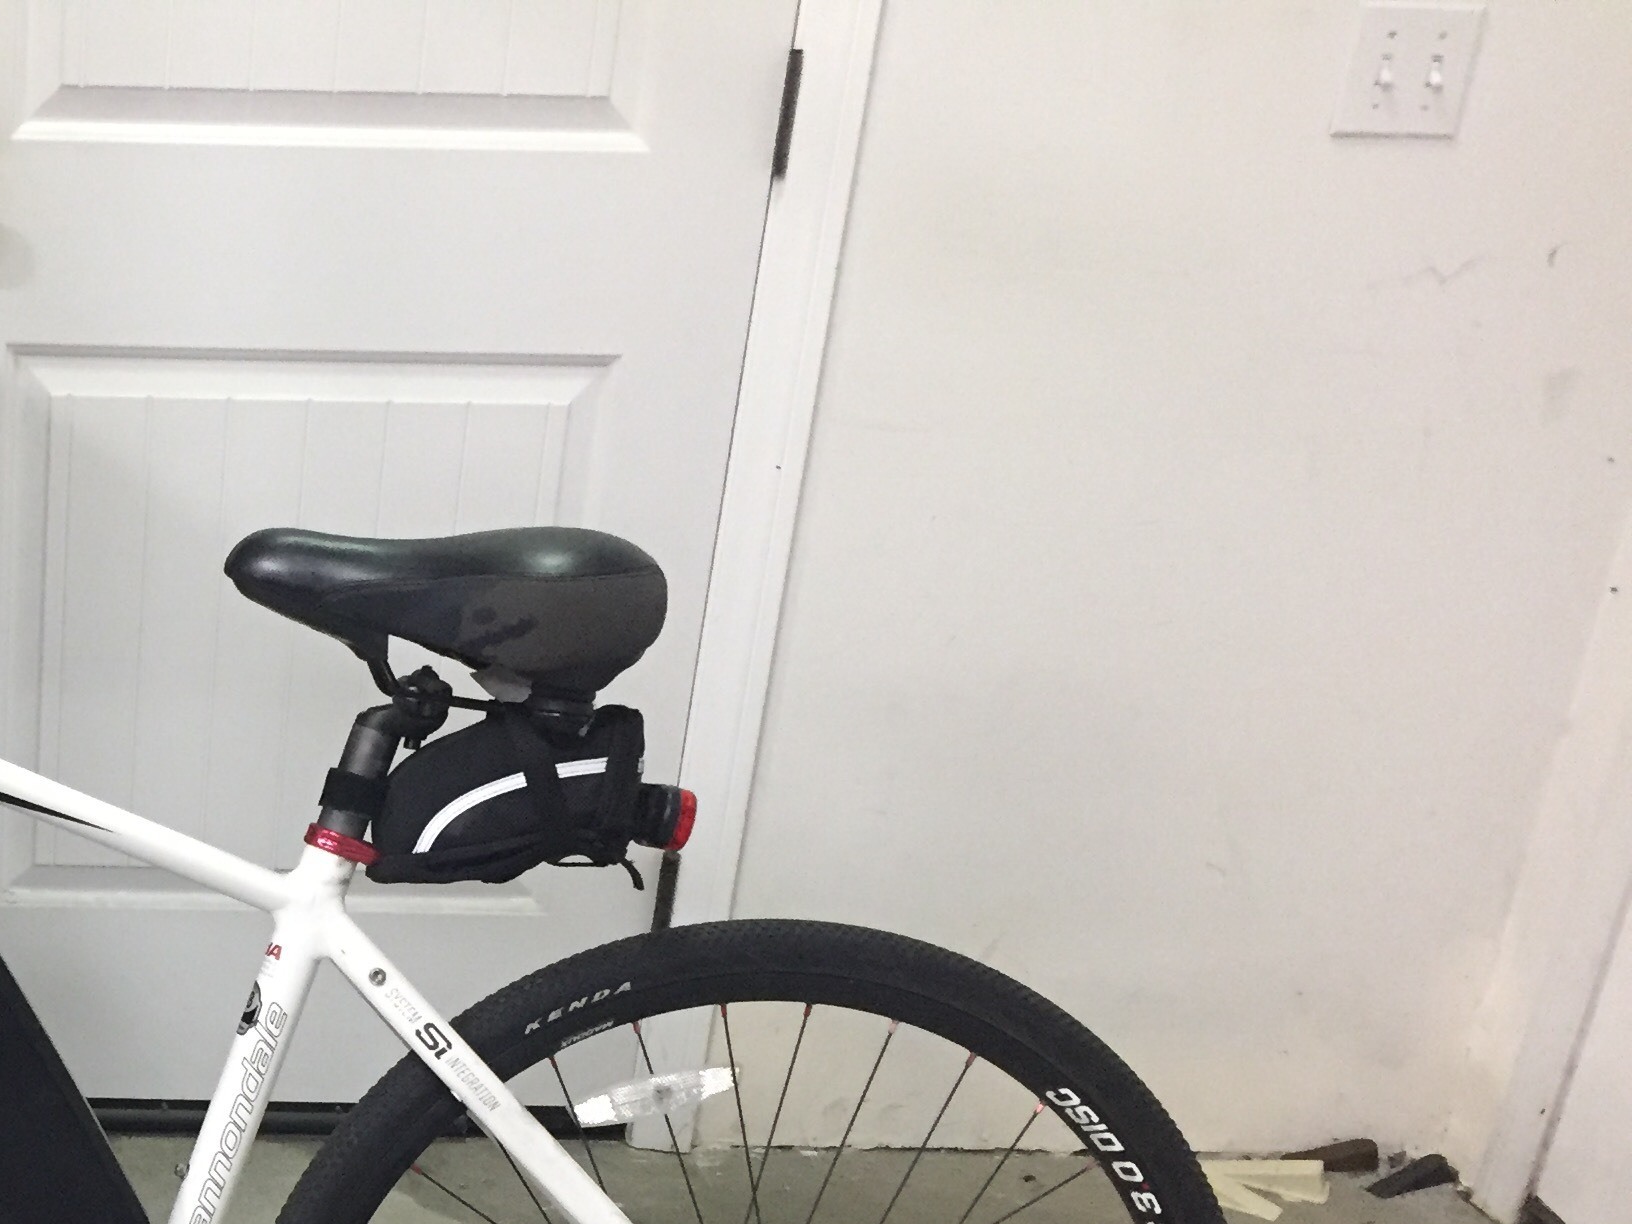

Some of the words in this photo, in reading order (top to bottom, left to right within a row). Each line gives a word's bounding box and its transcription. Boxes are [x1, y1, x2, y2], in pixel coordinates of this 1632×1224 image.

[524, 980, 632, 1035] KENDA
[445, 1054, 502, 1113] INTEGRATION
[1045, 1087, 1126, 1153] DISC
